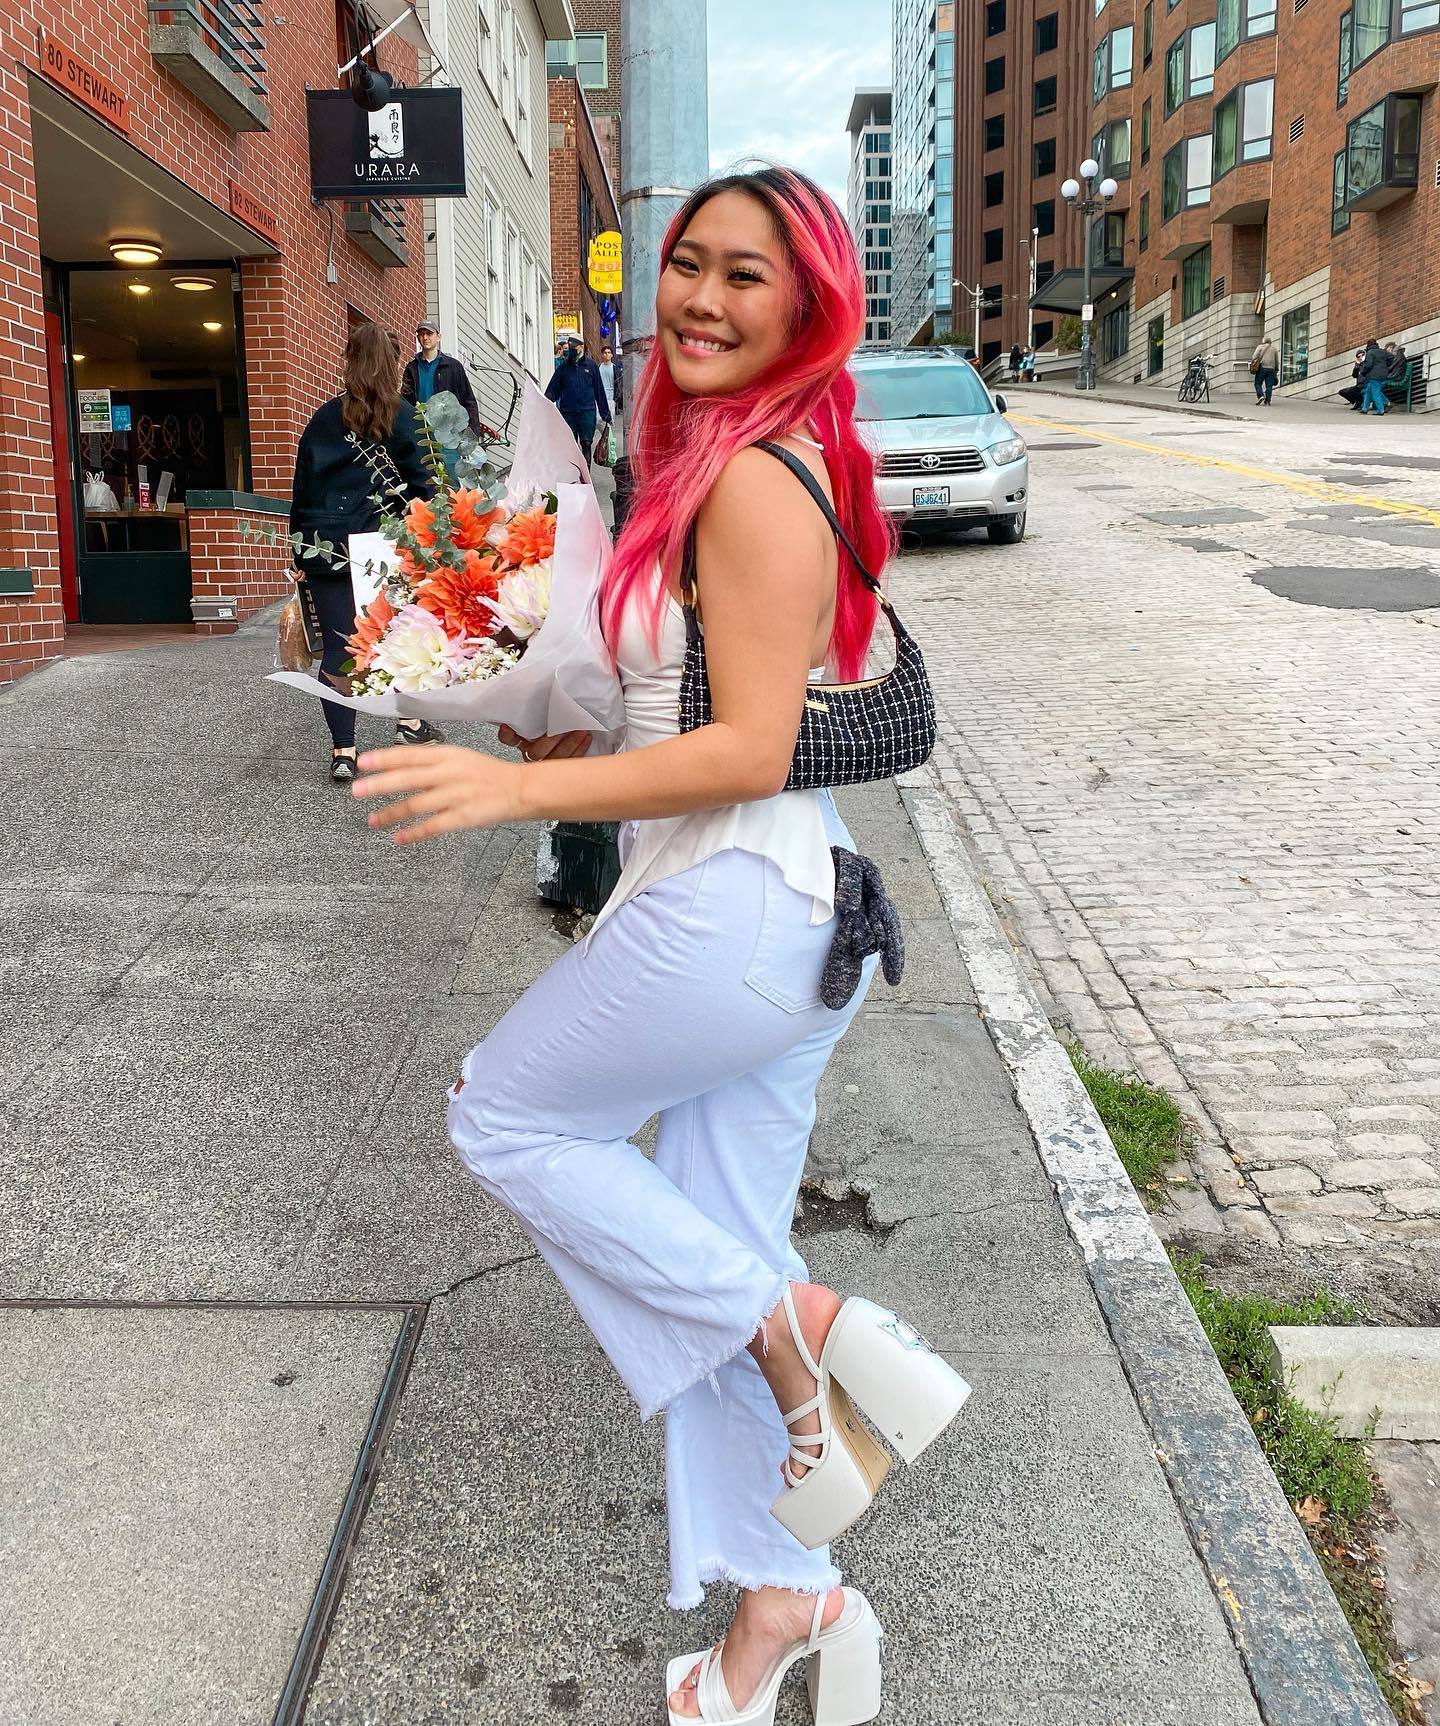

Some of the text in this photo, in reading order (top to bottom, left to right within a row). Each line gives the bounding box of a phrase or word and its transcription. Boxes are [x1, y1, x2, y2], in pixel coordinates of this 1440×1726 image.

[47, 43, 124, 118] 80 STEWART
[354, 162, 420, 177] URARA
[234, 189, 277, 234] 82 STEWART
